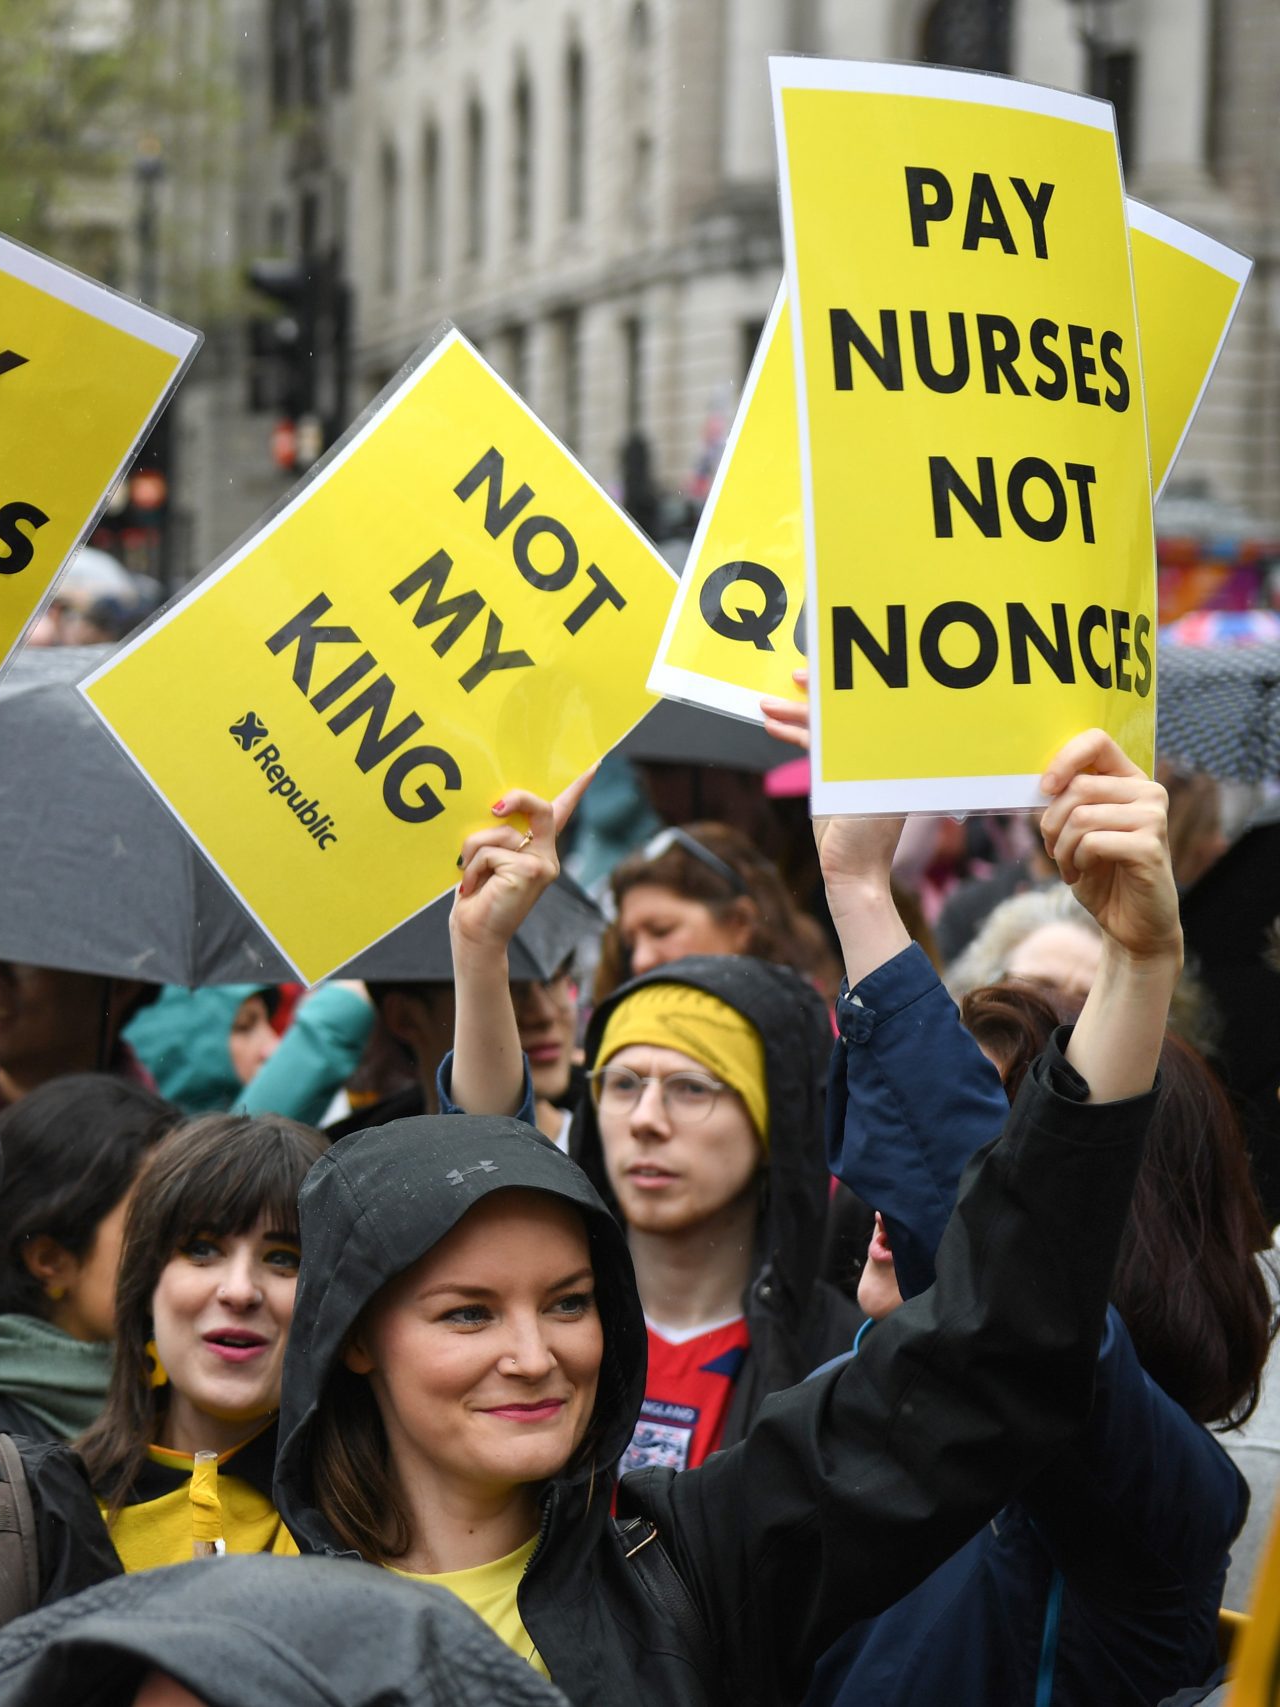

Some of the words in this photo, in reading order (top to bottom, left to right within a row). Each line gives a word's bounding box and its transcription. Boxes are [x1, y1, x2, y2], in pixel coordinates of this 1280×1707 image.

[905, 166, 1055, 260] PAY
[829, 308, 1131, 413] NURSES
[453, 446, 627, 637] NOT
[928, 456, 1097, 545] NOT
[389, 548, 535, 694] MY
[699, 560, 807, 657] Q
[832, 600, 1153, 698] NONCES
[265, 592, 462, 824] KING
[253, 743, 338, 851] Republic
[641, 1401, 695, 1422] NGLAND
